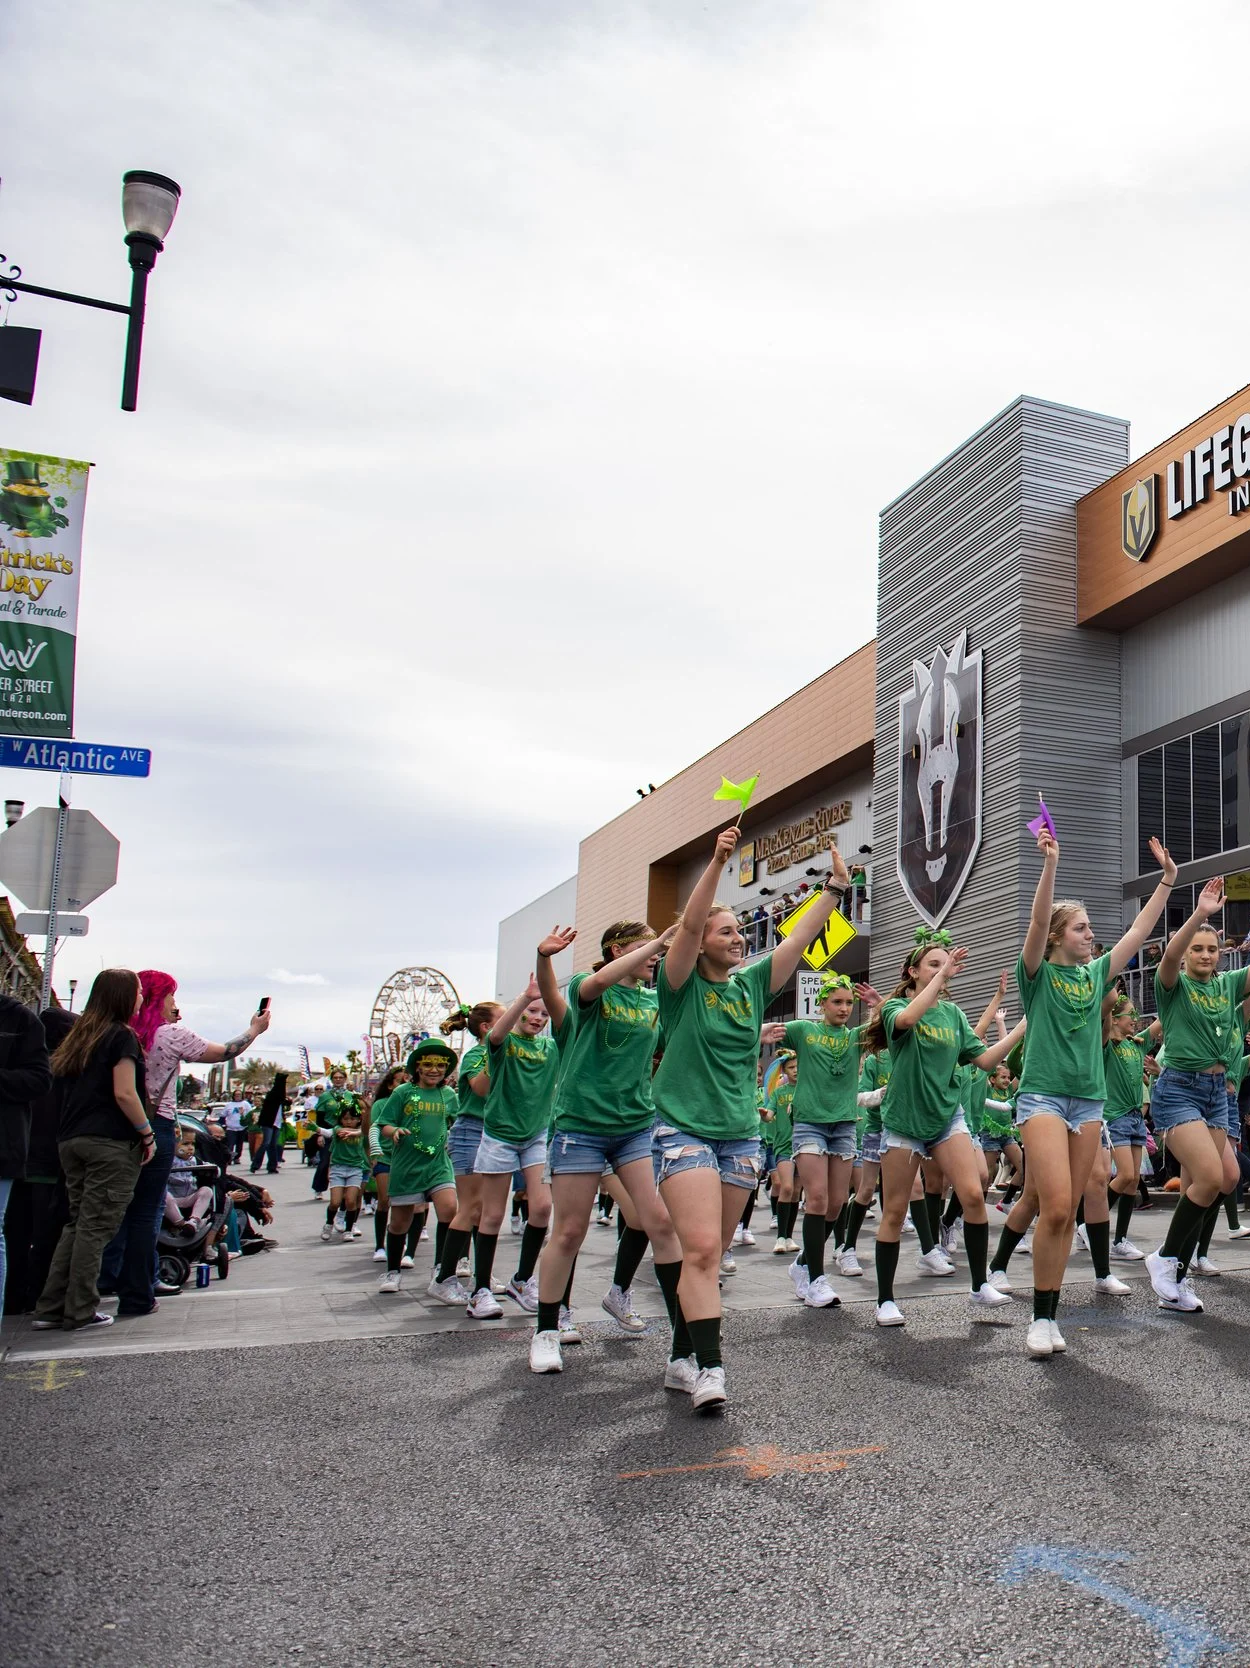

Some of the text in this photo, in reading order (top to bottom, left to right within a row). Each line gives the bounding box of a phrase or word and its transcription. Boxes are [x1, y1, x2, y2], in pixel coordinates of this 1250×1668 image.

[1229, 480, 1250, 516] IN
[0, 547, 73, 575] trick's
[0, 567, 52, 601] Day
[12, 600, 25, 615] &
[27, 602, 67, 618] Parade
[15, 679, 54, 693] STREET
[2, 692, 32, 703] LAZA
[0, 708, 67, 721] nderson.com
[12, 740, 23, 752] W
[23, 742, 116, 771] Atlantic
[119, 749, 145, 762] AVE
[813, 802, 847, 834] RIVER
[801, 976, 825, 986] SPE
[803, 987, 821, 995] LIM
